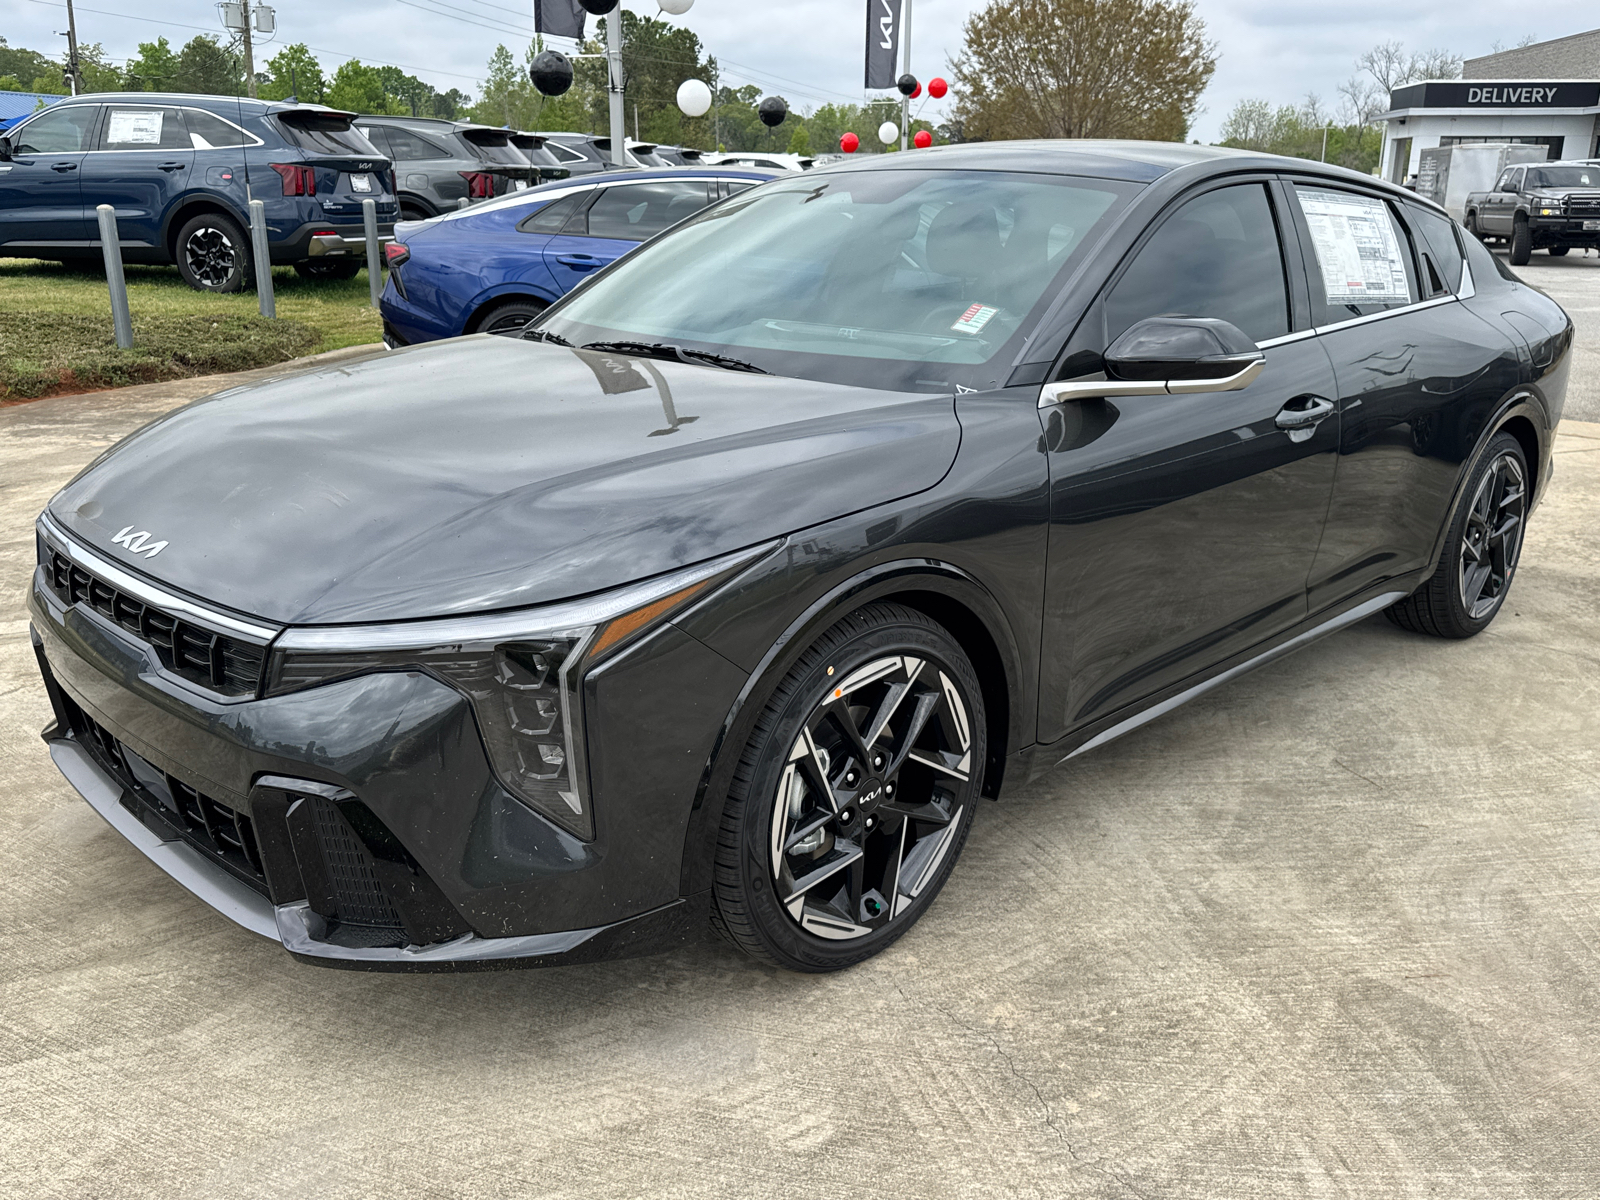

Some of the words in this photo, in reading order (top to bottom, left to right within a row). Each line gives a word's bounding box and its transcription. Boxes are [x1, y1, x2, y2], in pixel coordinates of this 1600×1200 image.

[1467, 87, 1558, 103] DELIVERY
[111, 525, 169, 559] KIA
[859, 786, 882, 804] KIA
